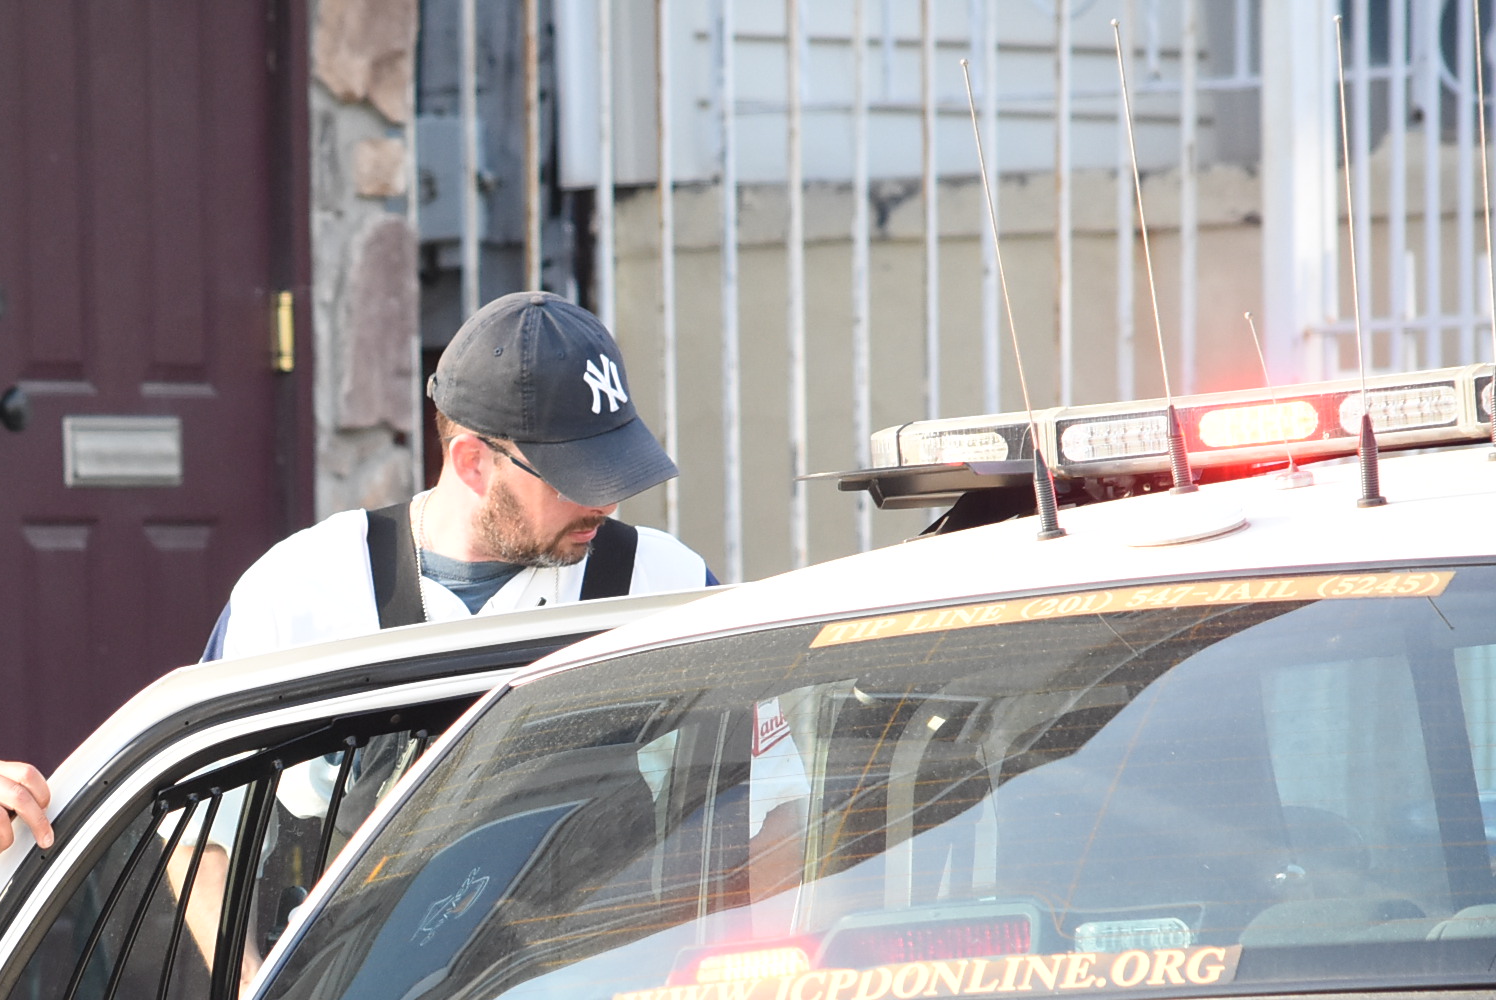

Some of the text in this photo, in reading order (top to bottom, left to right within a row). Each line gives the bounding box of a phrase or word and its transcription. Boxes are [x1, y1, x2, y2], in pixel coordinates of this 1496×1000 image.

[583, 353, 628, 415] NY
[828, 573, 1441, 643] TIP LINE (201) 547-JAIL (5245)
